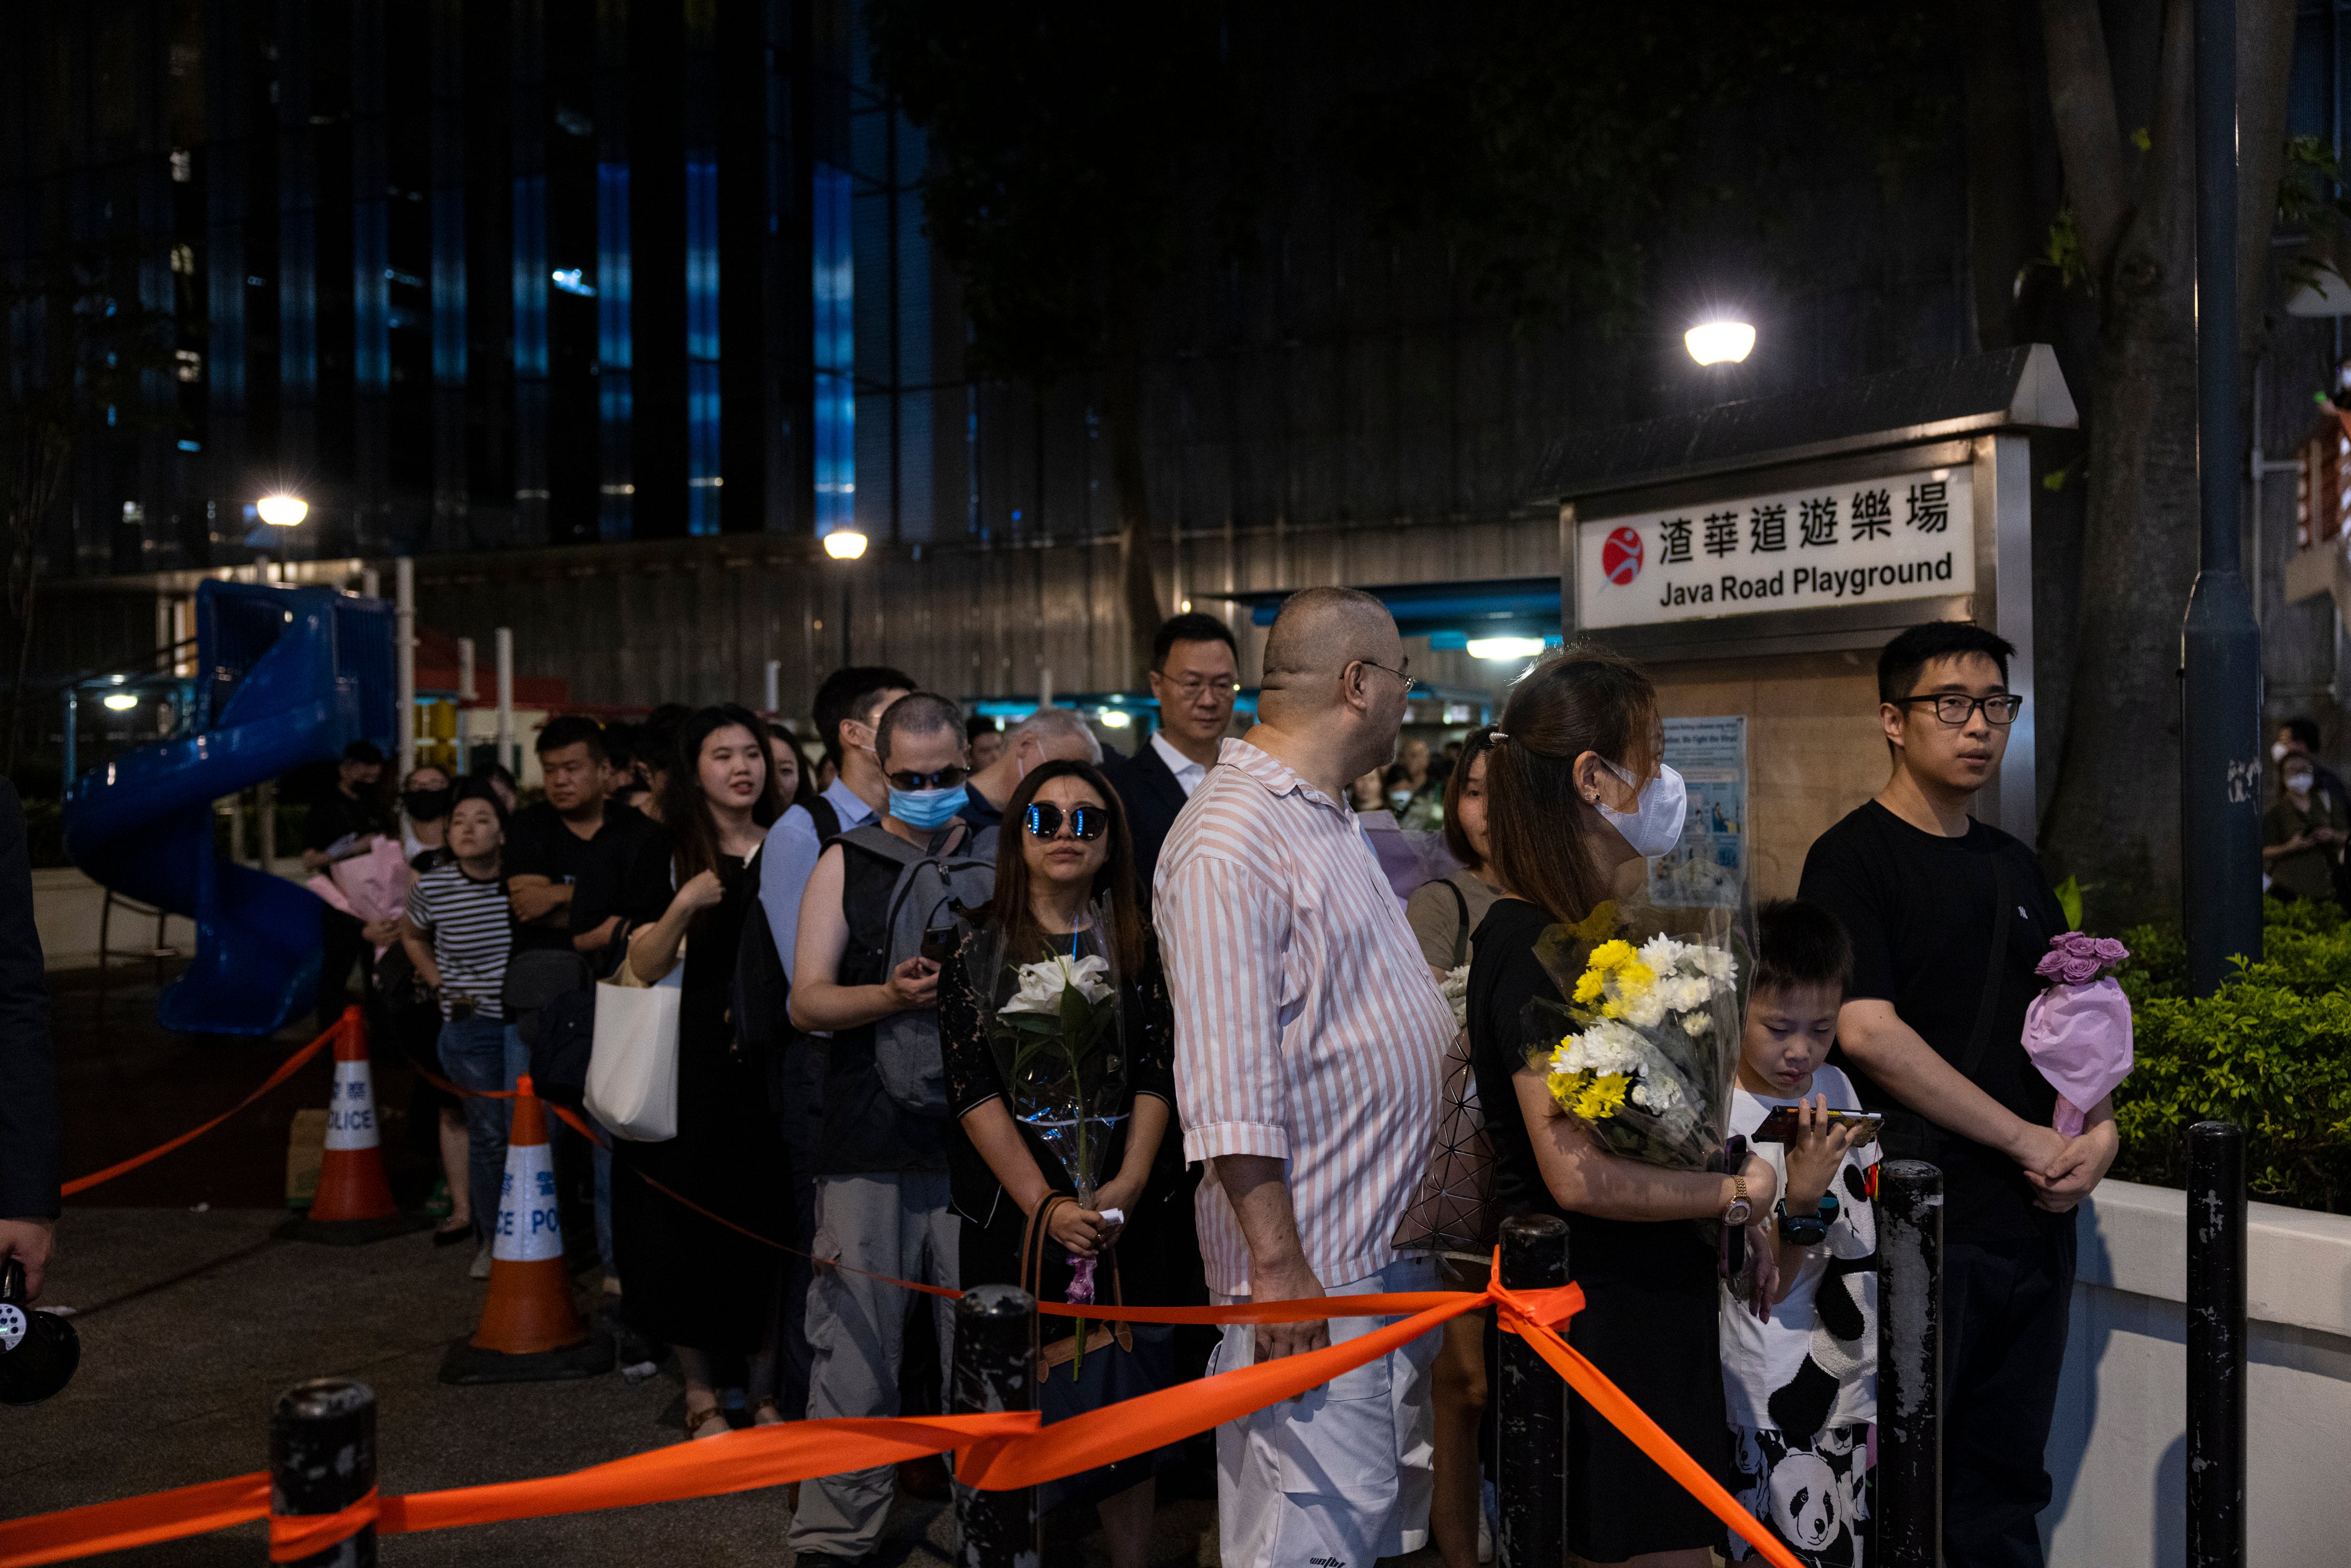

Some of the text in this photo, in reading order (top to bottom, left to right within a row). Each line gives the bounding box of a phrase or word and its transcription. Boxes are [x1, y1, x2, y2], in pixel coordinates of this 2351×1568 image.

[1659, 481, 1949, 564] 渣華道遊樂場
[1660, 552, 1952, 607] Java Road Playground
